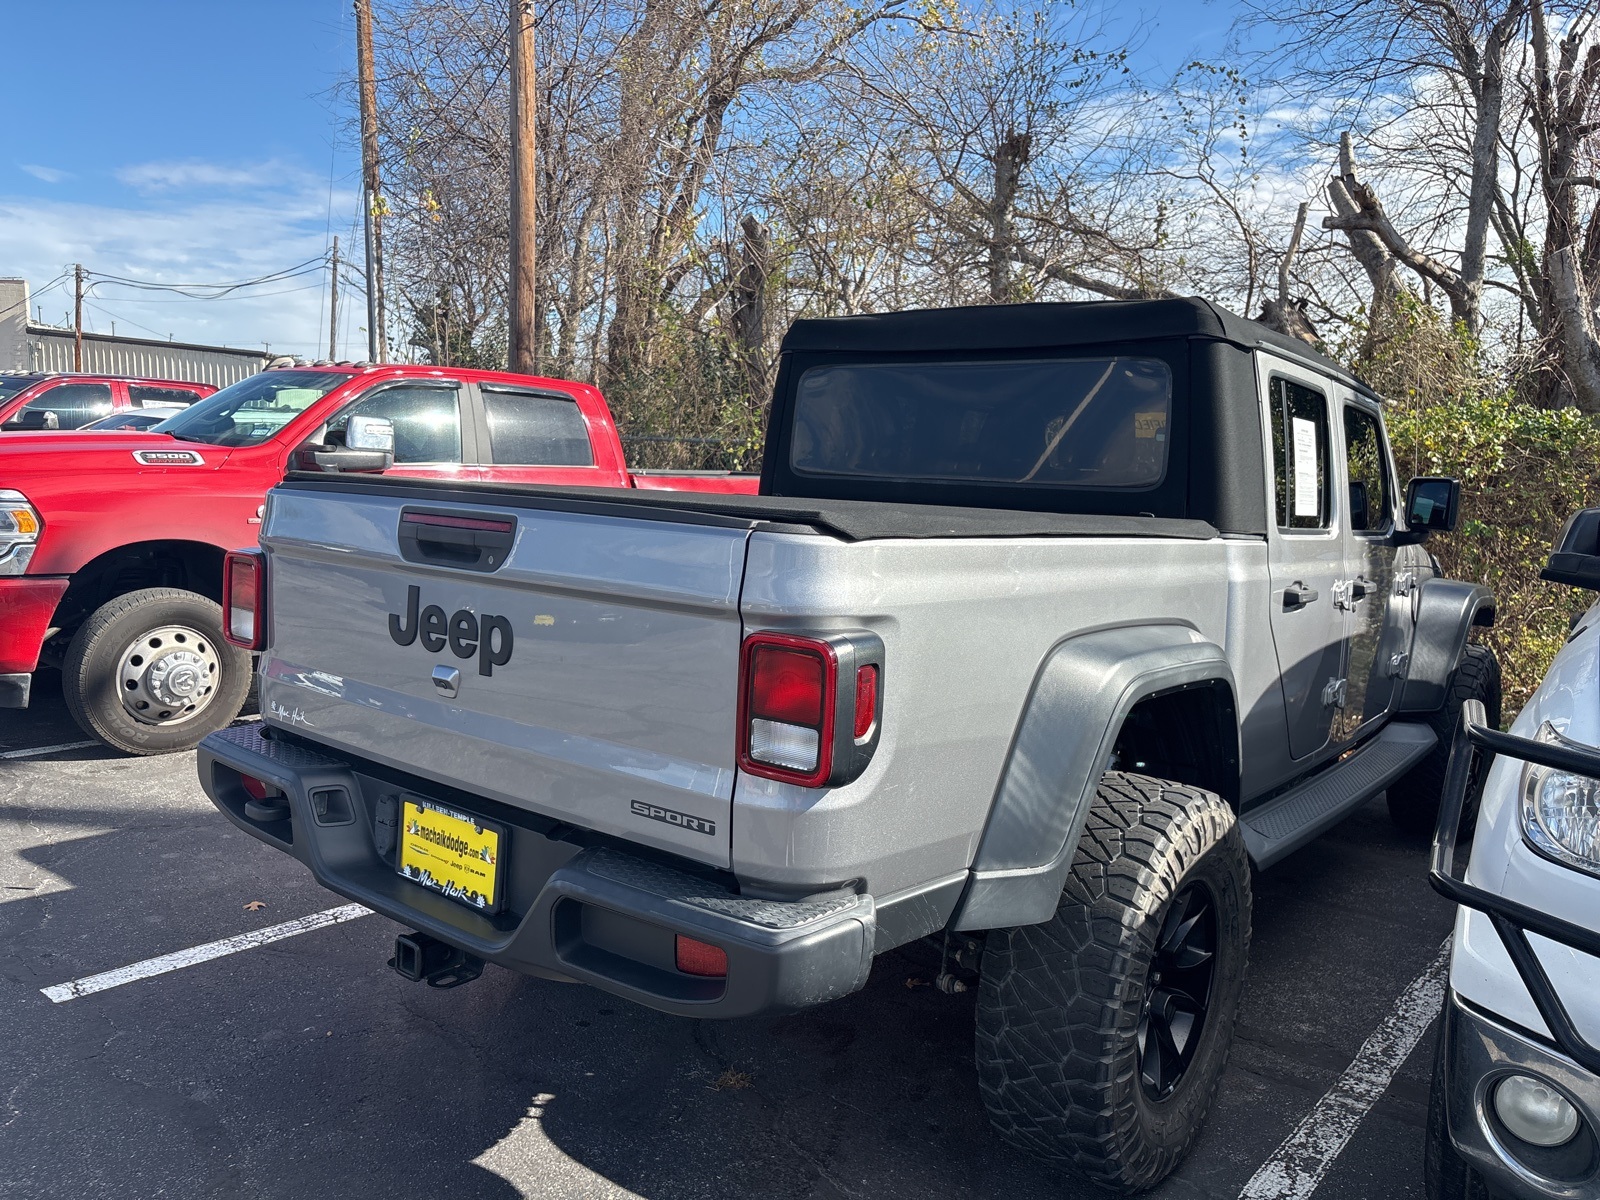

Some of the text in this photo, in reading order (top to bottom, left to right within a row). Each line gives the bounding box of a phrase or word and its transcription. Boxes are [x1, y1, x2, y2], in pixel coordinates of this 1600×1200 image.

[145, 452, 190, 460] 3500
[388, 584, 514, 678] Jeep
[422, 800, 475, 825] KILLEEN-TEMPLE
[631, 800, 716, 836] SPORT
[420, 825, 480, 859] machaikdodge.com
[450, 860, 463, 871] Jeep
[469, 868, 486, 877] RAM
